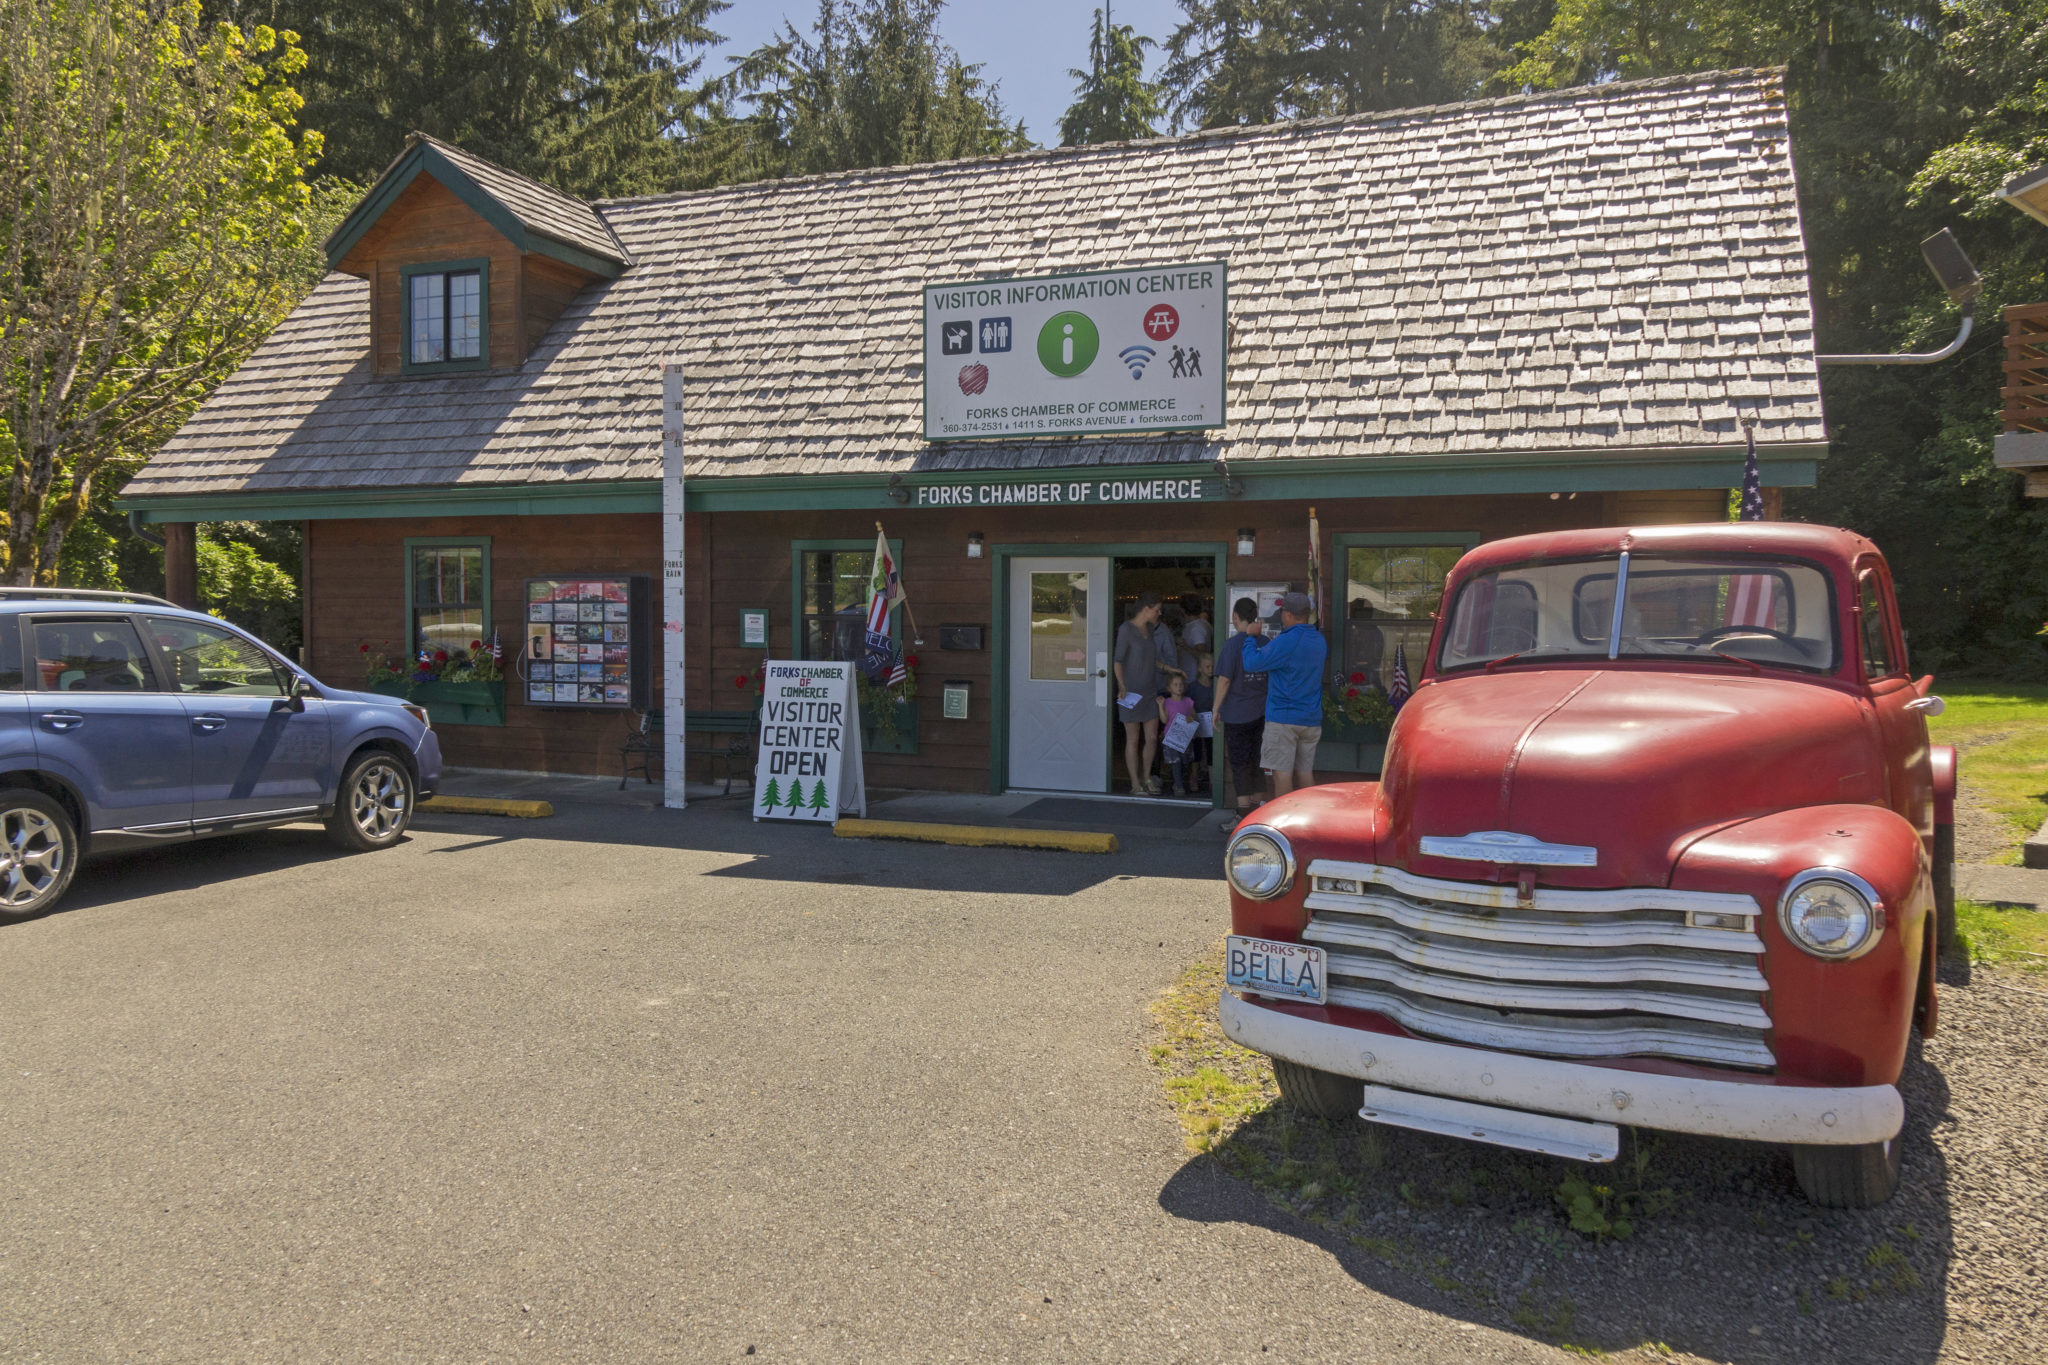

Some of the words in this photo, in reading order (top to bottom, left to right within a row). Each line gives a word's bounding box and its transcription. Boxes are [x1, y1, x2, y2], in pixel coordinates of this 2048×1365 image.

[934, 289, 1002, 311] VISITOR
[1007, 277, 1131, 305] INFORMATION
[1136, 271, 1213, 294] CENTER
[966, 407, 1008, 420] FORKS
[1011, 403, 1075, 417] CHAMBER
[1078, 402, 1095, 414] OF
[1098, 398, 1176, 413] COMMERCE
[942, 422, 1003, 433] 360-374-2531
[1013, 420, 1034, 430] 1411
[1037, 419, 1046, 429] S.
[1049, 417, 1083, 428] FORKS
[1085, 415, 1127, 426] AVENUE
[1139, 413, 1203, 424] forkswa.com
[918, 486, 973, 505] FORKS
[979, 483, 1062, 504] CHAMBER
[1068, 482, 1092, 502] OF
[1099, 479, 1203, 501] COMMERCE
[664, 560, 683, 568] FORKS
[665, 569, 682, 578] RAIN
[770, 666, 800, 679] FORKS
[801, 667, 844, 680] CHAMBER
[800, 678, 811, 687] OF
[780, 686, 829, 699] COMMERCE
[767, 701, 843, 727] VISITOR
[763, 726, 841, 752] CENTER
[769, 750, 827, 777] OPEN
[1252, 941, 1296, 957] FORKS
[1231, 949, 1317, 990] BELLA
